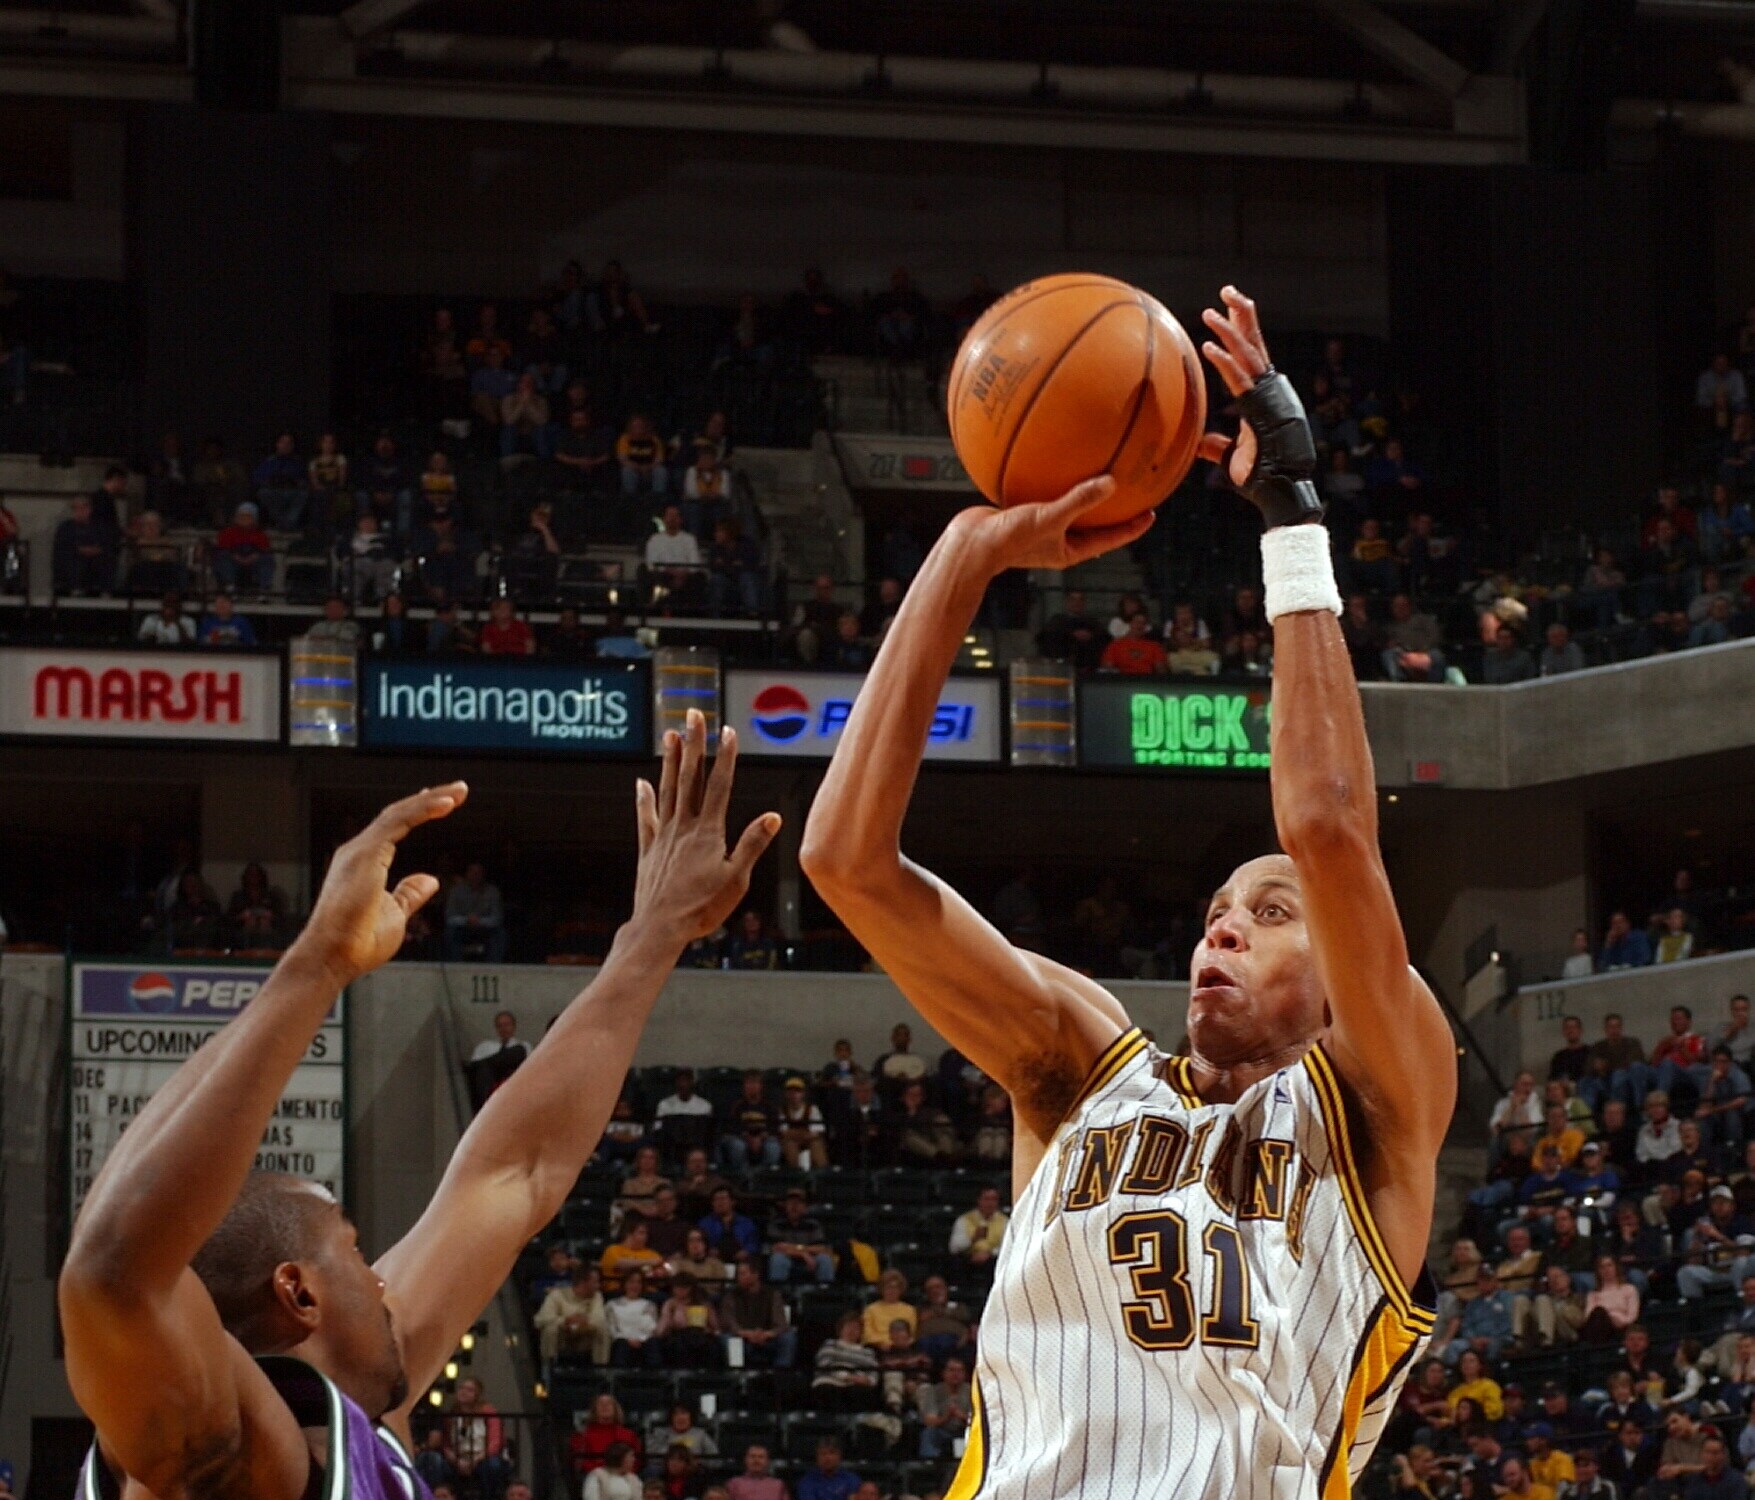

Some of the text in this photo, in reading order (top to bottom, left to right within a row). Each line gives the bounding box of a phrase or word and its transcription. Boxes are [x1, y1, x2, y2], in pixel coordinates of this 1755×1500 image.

[973, 354, 1007, 401] NBA
[33, 664, 242, 725] MARSH
[379, 671, 629, 737] Indianapolis
[541, 724, 628, 739] MONTHLY
[820, 699, 973, 742] PSI
[1135, 750, 1272, 768] SPORTING GOO
[182, 980, 260, 1009] PEP
[72, 1068, 105, 1089] DEC
[1107, 1208, 1260, 1352] 31
